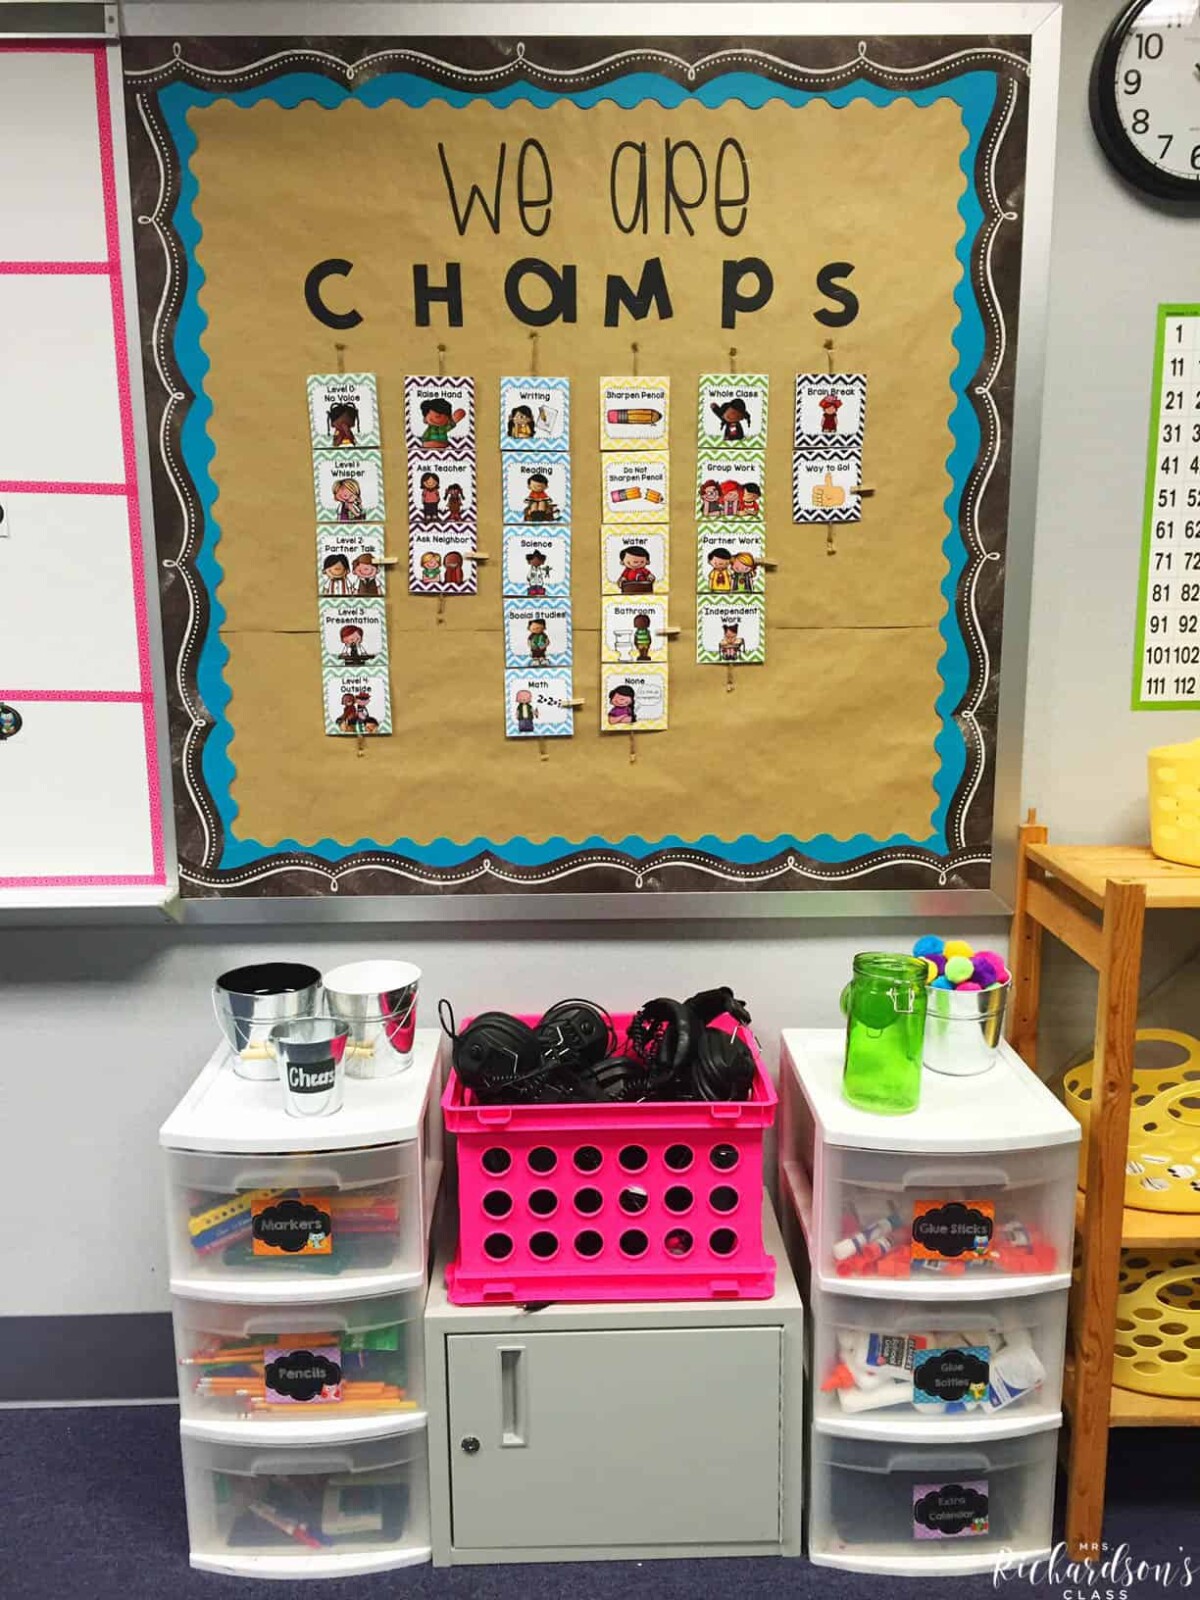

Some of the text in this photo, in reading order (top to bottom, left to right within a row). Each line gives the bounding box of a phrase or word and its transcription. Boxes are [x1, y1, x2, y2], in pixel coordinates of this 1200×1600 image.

[1135, 33, 1163, 59] 10
[1123, 69, 1142, 95] 9
[1131, 109, 1150, 134] 8
[1157, 135, 1173, 159] 7
[1176, 324, 1183, 343] 1
[1171, 357, 1184, 376] 11
[326, 384, 348, 392] Level
[808, 388, 828, 396] Brain
[324, 394, 360, 402] No Voice
[417, 390, 462, 398] Raise Hand
[519, 392, 550, 401] Writing
[606, 391, 664, 400] Sharpen Pencil
[1165, 391, 1183, 410] 21
[1163, 424, 1181, 443] 31
[334, 460, 355, 468] Level
[434, 464, 467, 472] Teacher
[707, 464, 732, 472] Group
[1161, 456, 1178, 474] 41
[331, 469, 365, 478] Whisper
[520, 466, 553, 475] Reading
[806, 465, 824, 473] Way
[1158, 489, 1175, 507] 51
[1156, 521, 1173, 539] 61
[336, 536, 356, 544] Level
[416, 535, 470, 545] Ask Neighbor
[520, 540, 553, 548] Science
[622, 537, 648, 545] Water
[703, 536, 760, 544] Partner Work
[1155, 552, 1200, 570] 71 72
[1152, 584, 1200, 602] 81 82
[338, 608, 358, 616] Level
[535, 611, 566, 619] Studies
[614, 607, 656, 615] Bathroom
[704, 607, 758, 616] Independent
[326, 616, 379, 624] Presentation
[1150, 615, 1198, 633] 91 92
[1146, 646, 1200, 664] 101 102
[528, 681, 548, 689] Math
[624, 677, 645, 685] None
[341, 685, 372, 693] Outside
[1146, 677, 1196, 695] 111 112
[289, 1067, 335, 1087] Cheers
[260, 1219, 323, 1232] Markers
[919, 1223, 988, 1235] Glue Sticks
[940, 1362, 965, 1373] Glue
[278, 1368, 327, 1380] Pencils
[934, 1378, 969, 1388] Bottles
